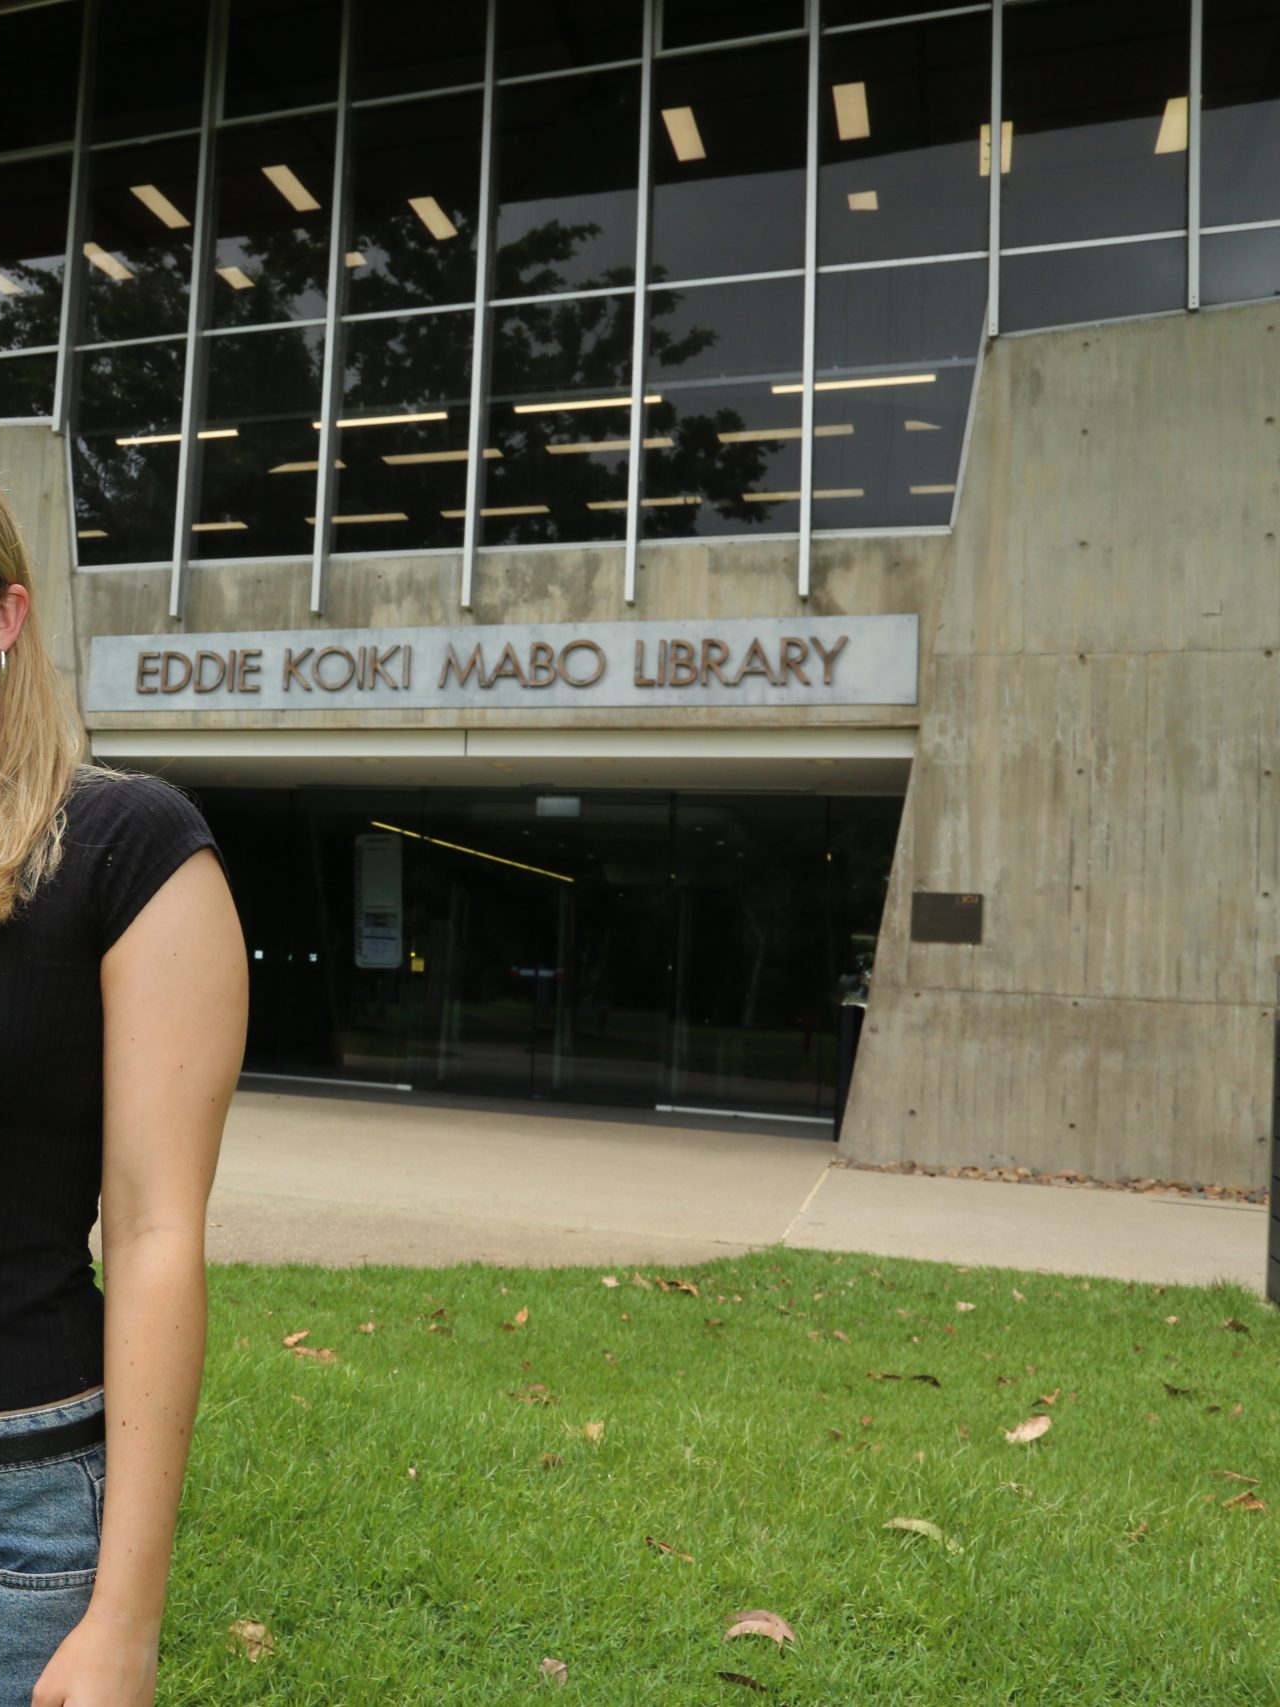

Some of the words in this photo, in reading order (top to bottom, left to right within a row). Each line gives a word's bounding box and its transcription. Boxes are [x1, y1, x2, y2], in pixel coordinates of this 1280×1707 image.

[135, 648, 262, 694] EDDIE
[282, 645, 412, 692] KOIKI
[438, 639, 606, 689] MABO
[633, 635, 849, 687] LIBRARY
